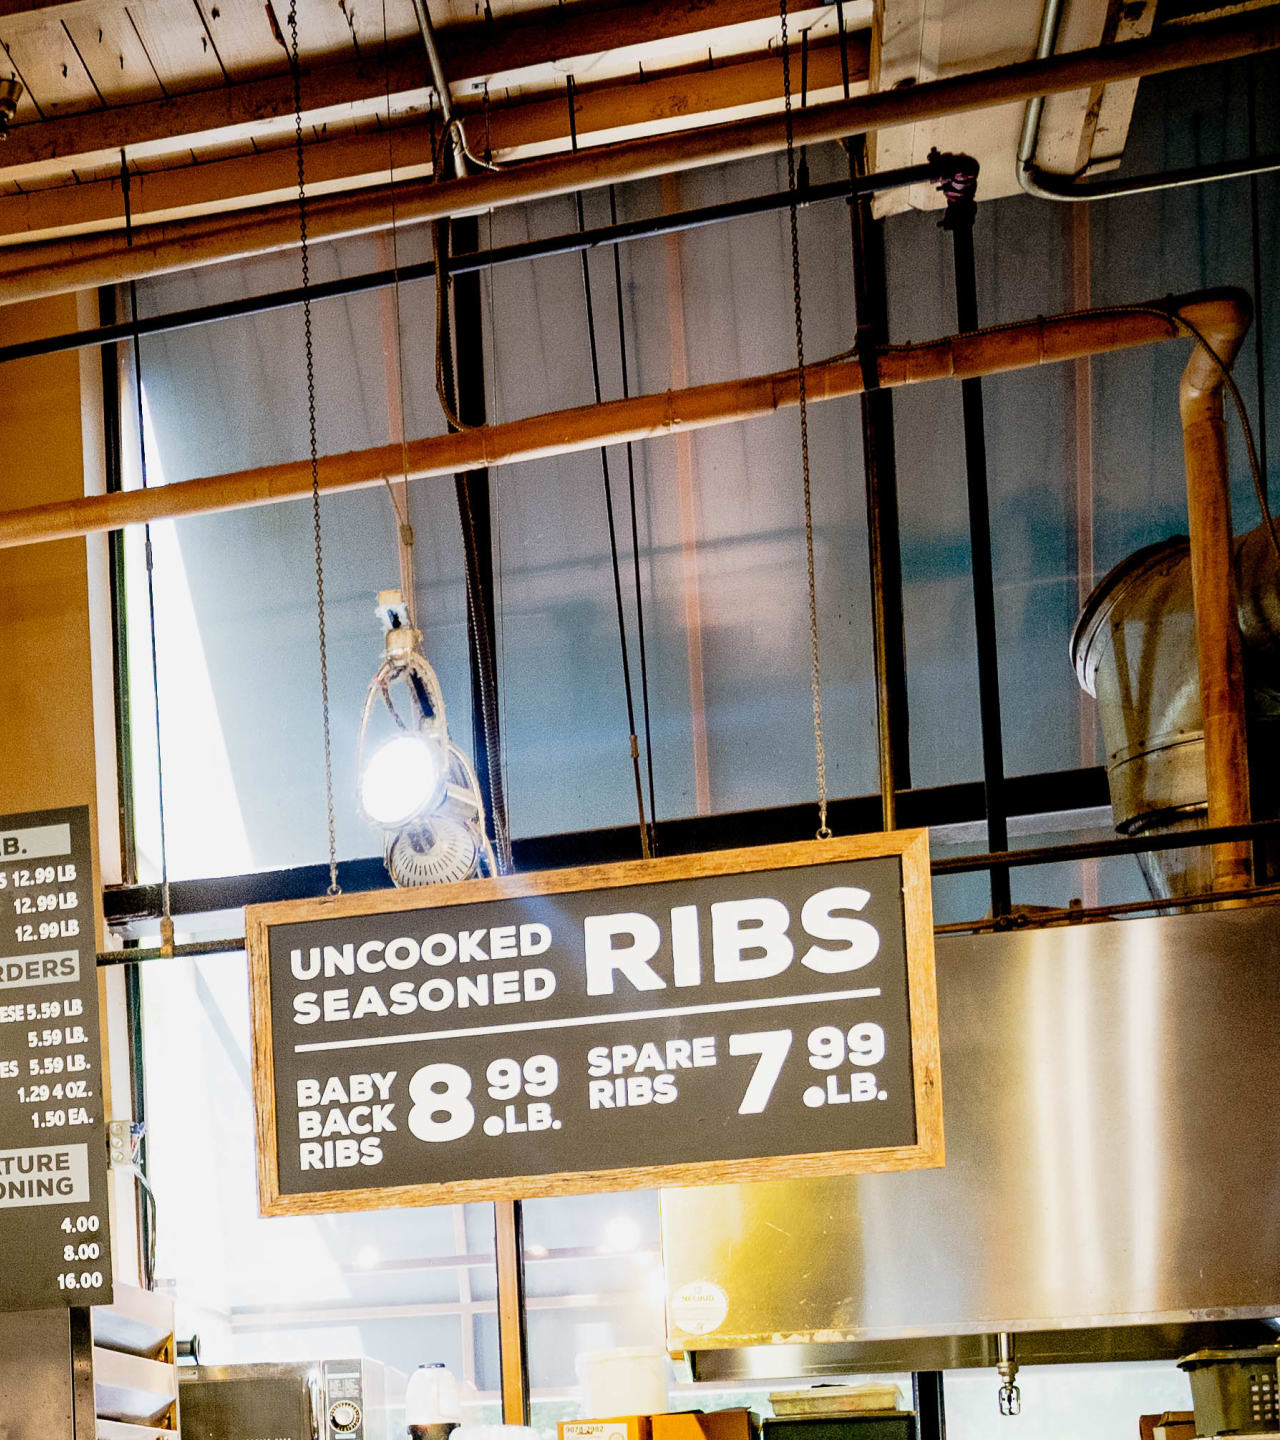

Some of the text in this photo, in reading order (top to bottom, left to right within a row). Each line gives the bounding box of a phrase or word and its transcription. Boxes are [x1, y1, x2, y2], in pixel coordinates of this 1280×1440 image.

[12, 867, 56, 888] 12.99
[57, 863, 78, 883] LB
[13, 894, 58, 915] 12.99
[58, 891, 80, 911] LB
[15, 922, 60, 943] 12.99
[60, 918, 81, 938] LB
[289, 886, 882, 998] UNCOOKED RIBS
[291, 966, 558, 1027] SEASONED
[26, 1000, 62, 1021] 5.59
[63, 998, 84, 1017] LB
[27, 1028, 63, 1048] 5.59
[65, 1025, 89, 1045] LB.
[29, 1056, 65, 1076] 5.59
[66, 1053, 91, 1072] LB.
[586, 1035, 718, 1079] SPARE
[17, 1084, 50, 1104] 1.29
[52, 1083, 64, 1100] 4
[65, 1079, 94, 1099] OZ.
[296, 1070, 398, 1109] BABY
[588, 1073, 679, 1112] RIBS
[31, 1110, 66, 1129] 1.50
[68, 1107, 95, 1126] EA.
[297, 1103, 398, 1141] BACK
[298, 1136, 385, 1172] RIBS
[60, 1214, 101, 1234] 4.00
[63, 1242, 101, 1262] 8.00
[56, 1271, 104, 1290] 16.00
